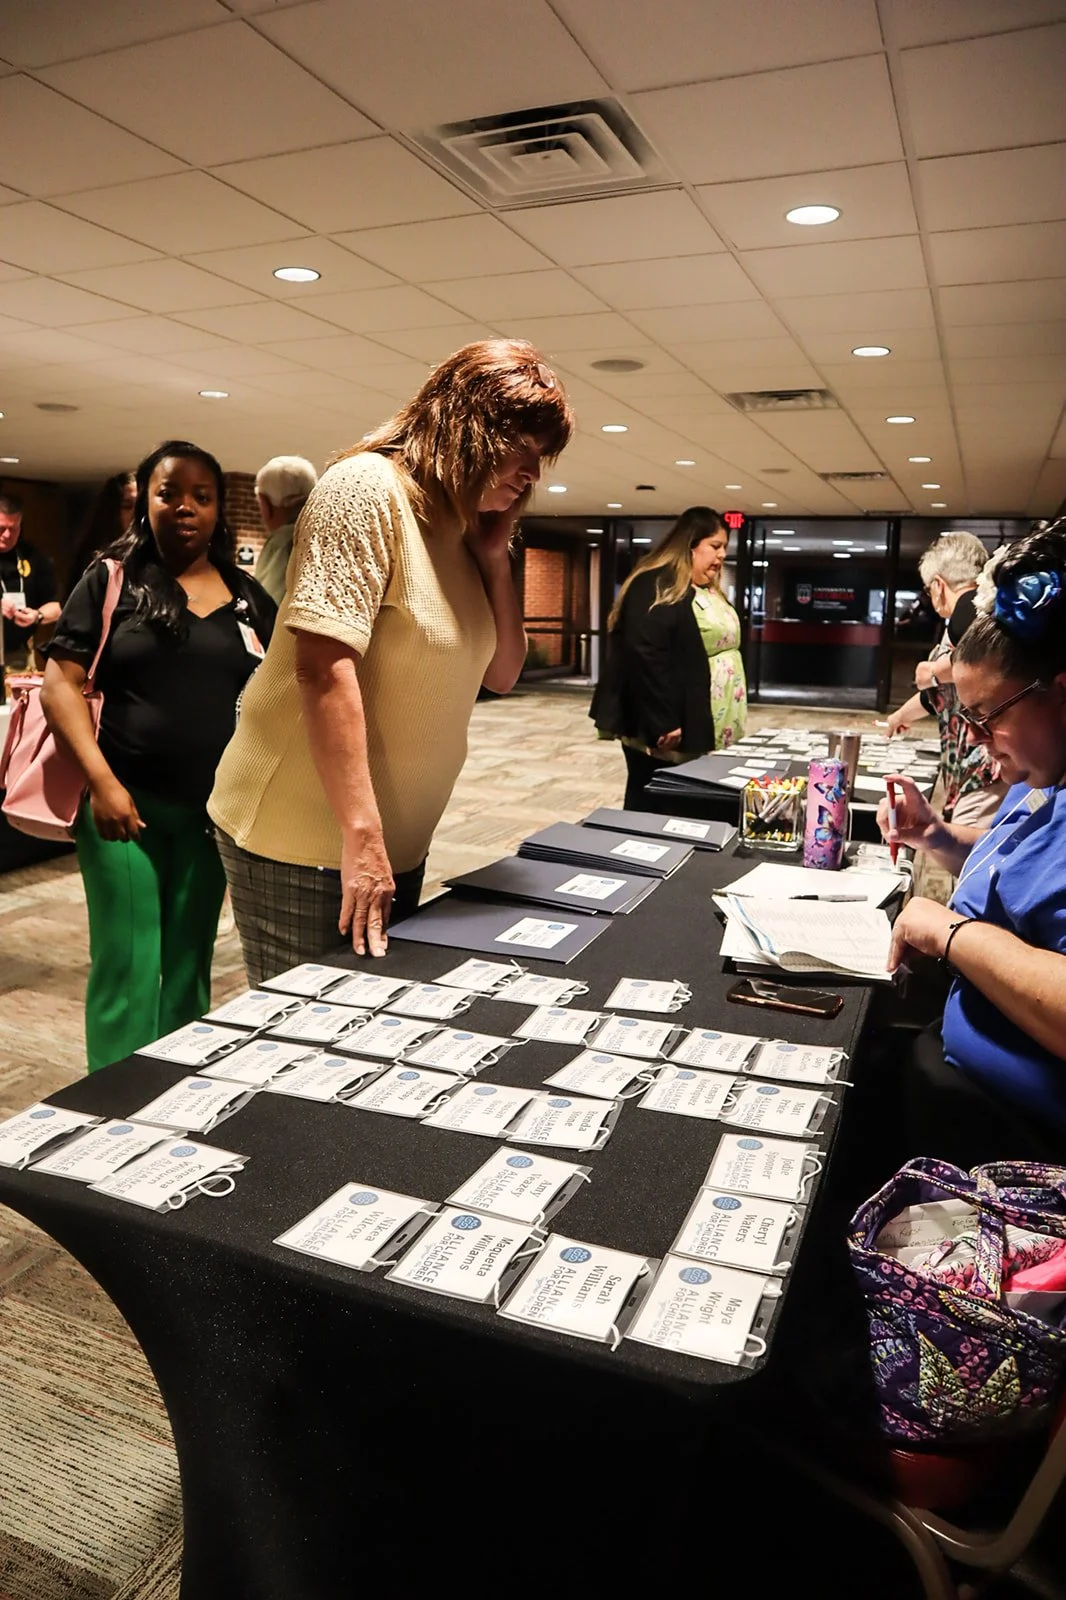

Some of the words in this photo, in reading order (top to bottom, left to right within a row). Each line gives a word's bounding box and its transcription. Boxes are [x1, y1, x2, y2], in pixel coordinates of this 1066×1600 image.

[156, 1092, 195, 1121] ALLIANCE
[666, 1082, 688, 1109] ALLIANCE
[537, 1110, 561, 1140] ALLIANCE
[578, 1111, 598, 1131] Brenda
[748, 1097, 771, 1125] ALLIANCE
[59, 1137, 111, 1171] ALLIANCE
[762, 1151, 779, 1179] Spooner
[780, 1157, 794, 1175] Jodie
[115, 1159, 172, 1193] ALLIANCE
[510, 1173, 541, 1197] Veazey
[737, 1153, 756, 1189] ALLIANCE
[479, 1171, 517, 1208] ALLIANCE
[529, 1179, 552, 1197] Amy
[308, 1209, 357, 1250] ALLIANCE
[346, 1211, 383, 1239] Wilcox
[365, 1217, 396, 1241] Nikea
[695, 1223, 716, 1254] CHILDREN
[705, 1214, 731, 1256] ALLIANCE
[735, 1214, 757, 1242] Waters
[753, 1217, 774, 1245] Cheryl
[413, 1245, 446, 1280] CHILDREN
[422, 1234, 464, 1282] ALLIANCE
[459, 1234, 495, 1270] Williams
[477, 1237, 513, 1276] Maquetta
[527, 1279, 556, 1317] CHILDREN
[576, 1265, 607, 1306] Williams
[596, 1275, 621, 1304] Sarah
[655, 1302, 679, 1342] CHILDREN
[699, 1291, 722, 1323] Wright
[721, 1297, 742, 1324] Maya
